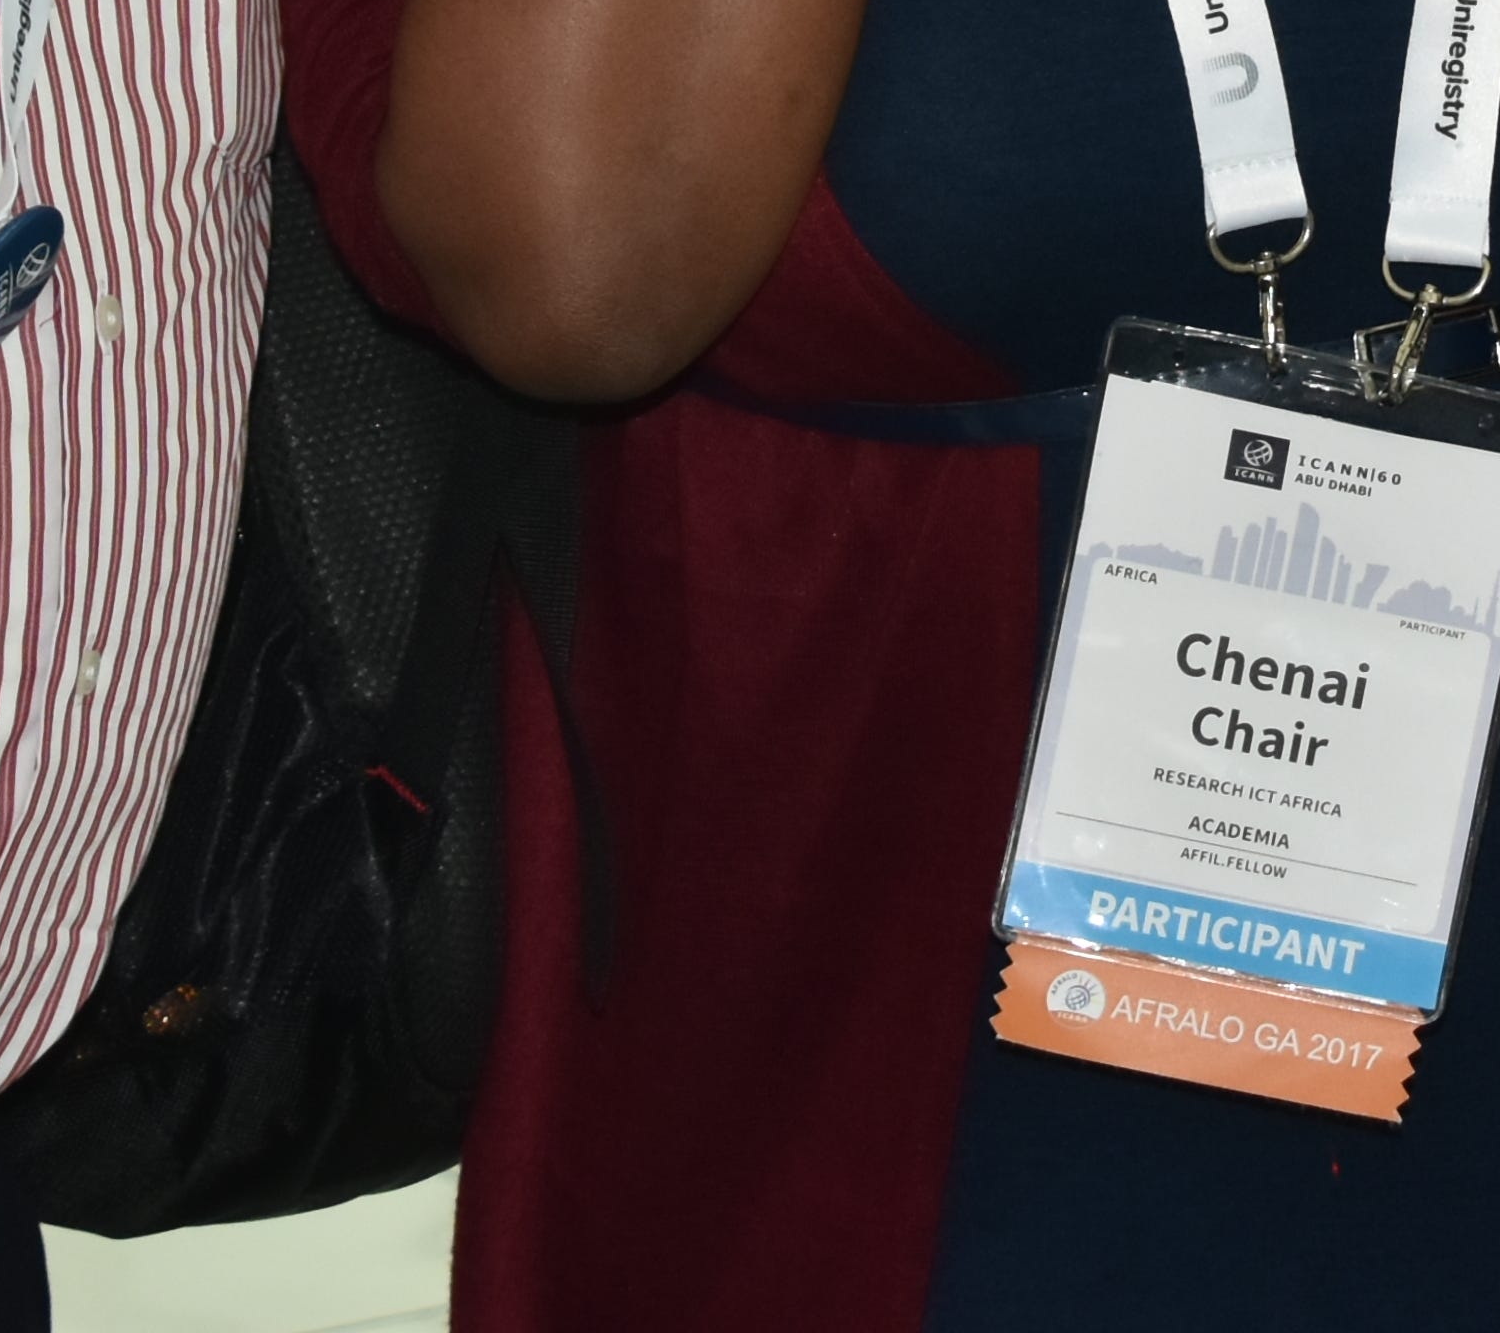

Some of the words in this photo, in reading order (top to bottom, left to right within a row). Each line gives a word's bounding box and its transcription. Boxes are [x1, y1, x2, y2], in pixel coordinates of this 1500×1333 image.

[1294, 472, 1325, 488] ABU
[1328, 479, 1373, 498] DHABI
[1104, 562, 1159, 585] AFRICA
[1399, 619, 1467, 641] PARTICIPANT
[1175, 632, 1369, 710] Chenai
[1190, 706, 1329, 767] Chair
[1153, 767, 1244, 800] RESEARCH
[1248, 786, 1277, 805] ICT
[1280, 793, 1343, 819] AFRICA
[1188, 815, 1290, 850] ACADEMIA
[1180, 846, 1287, 879] AFFIL.FELLOW
[1088, 889, 1365, 975] PARTICIPANT
[1110, 993, 1244, 1044] AFRALO
[1253, 1023, 1301, 1057] GA
[1306, 1032, 1383, 1072] 2017
